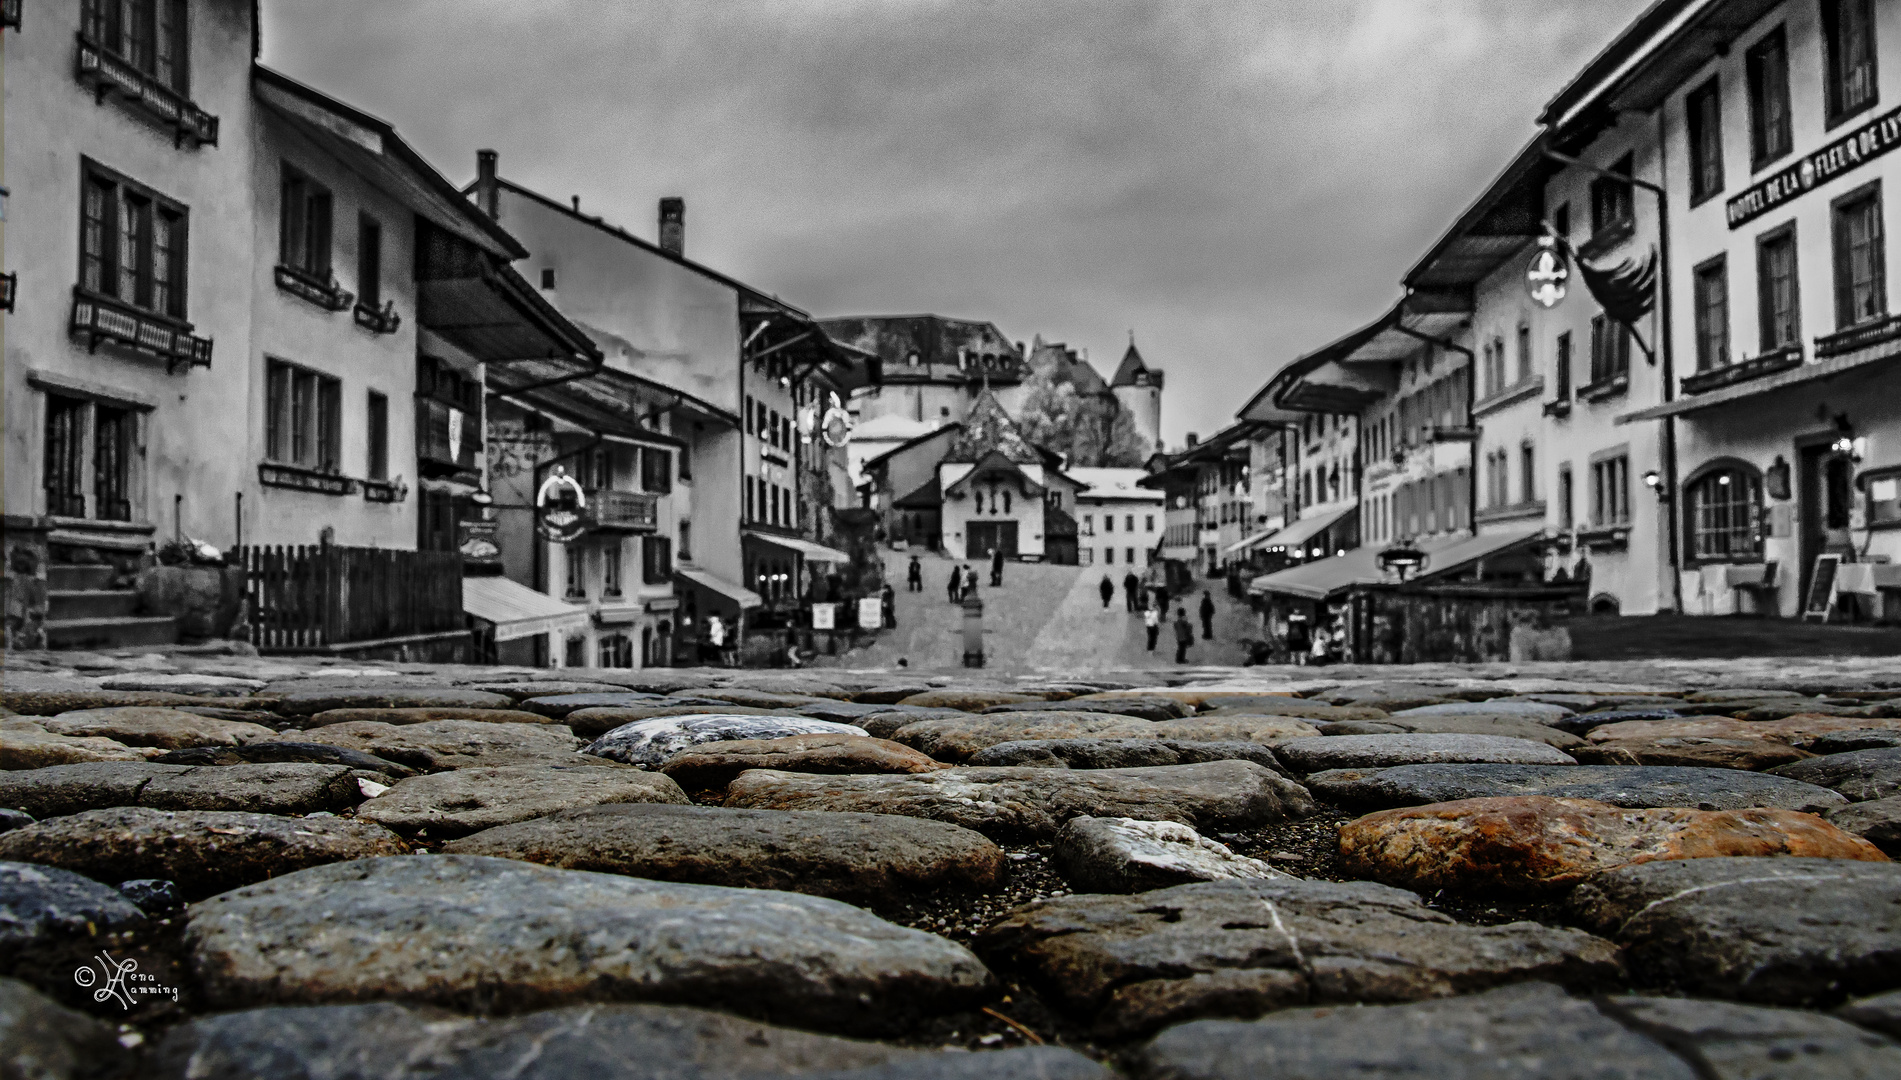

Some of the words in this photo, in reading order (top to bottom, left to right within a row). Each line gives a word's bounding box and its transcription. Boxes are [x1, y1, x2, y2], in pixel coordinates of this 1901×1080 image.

[1782, 172, 1799, 195] LA
[1815, 138, 1861, 178] FLEUR
[1859, 126, 1879, 155] DE
